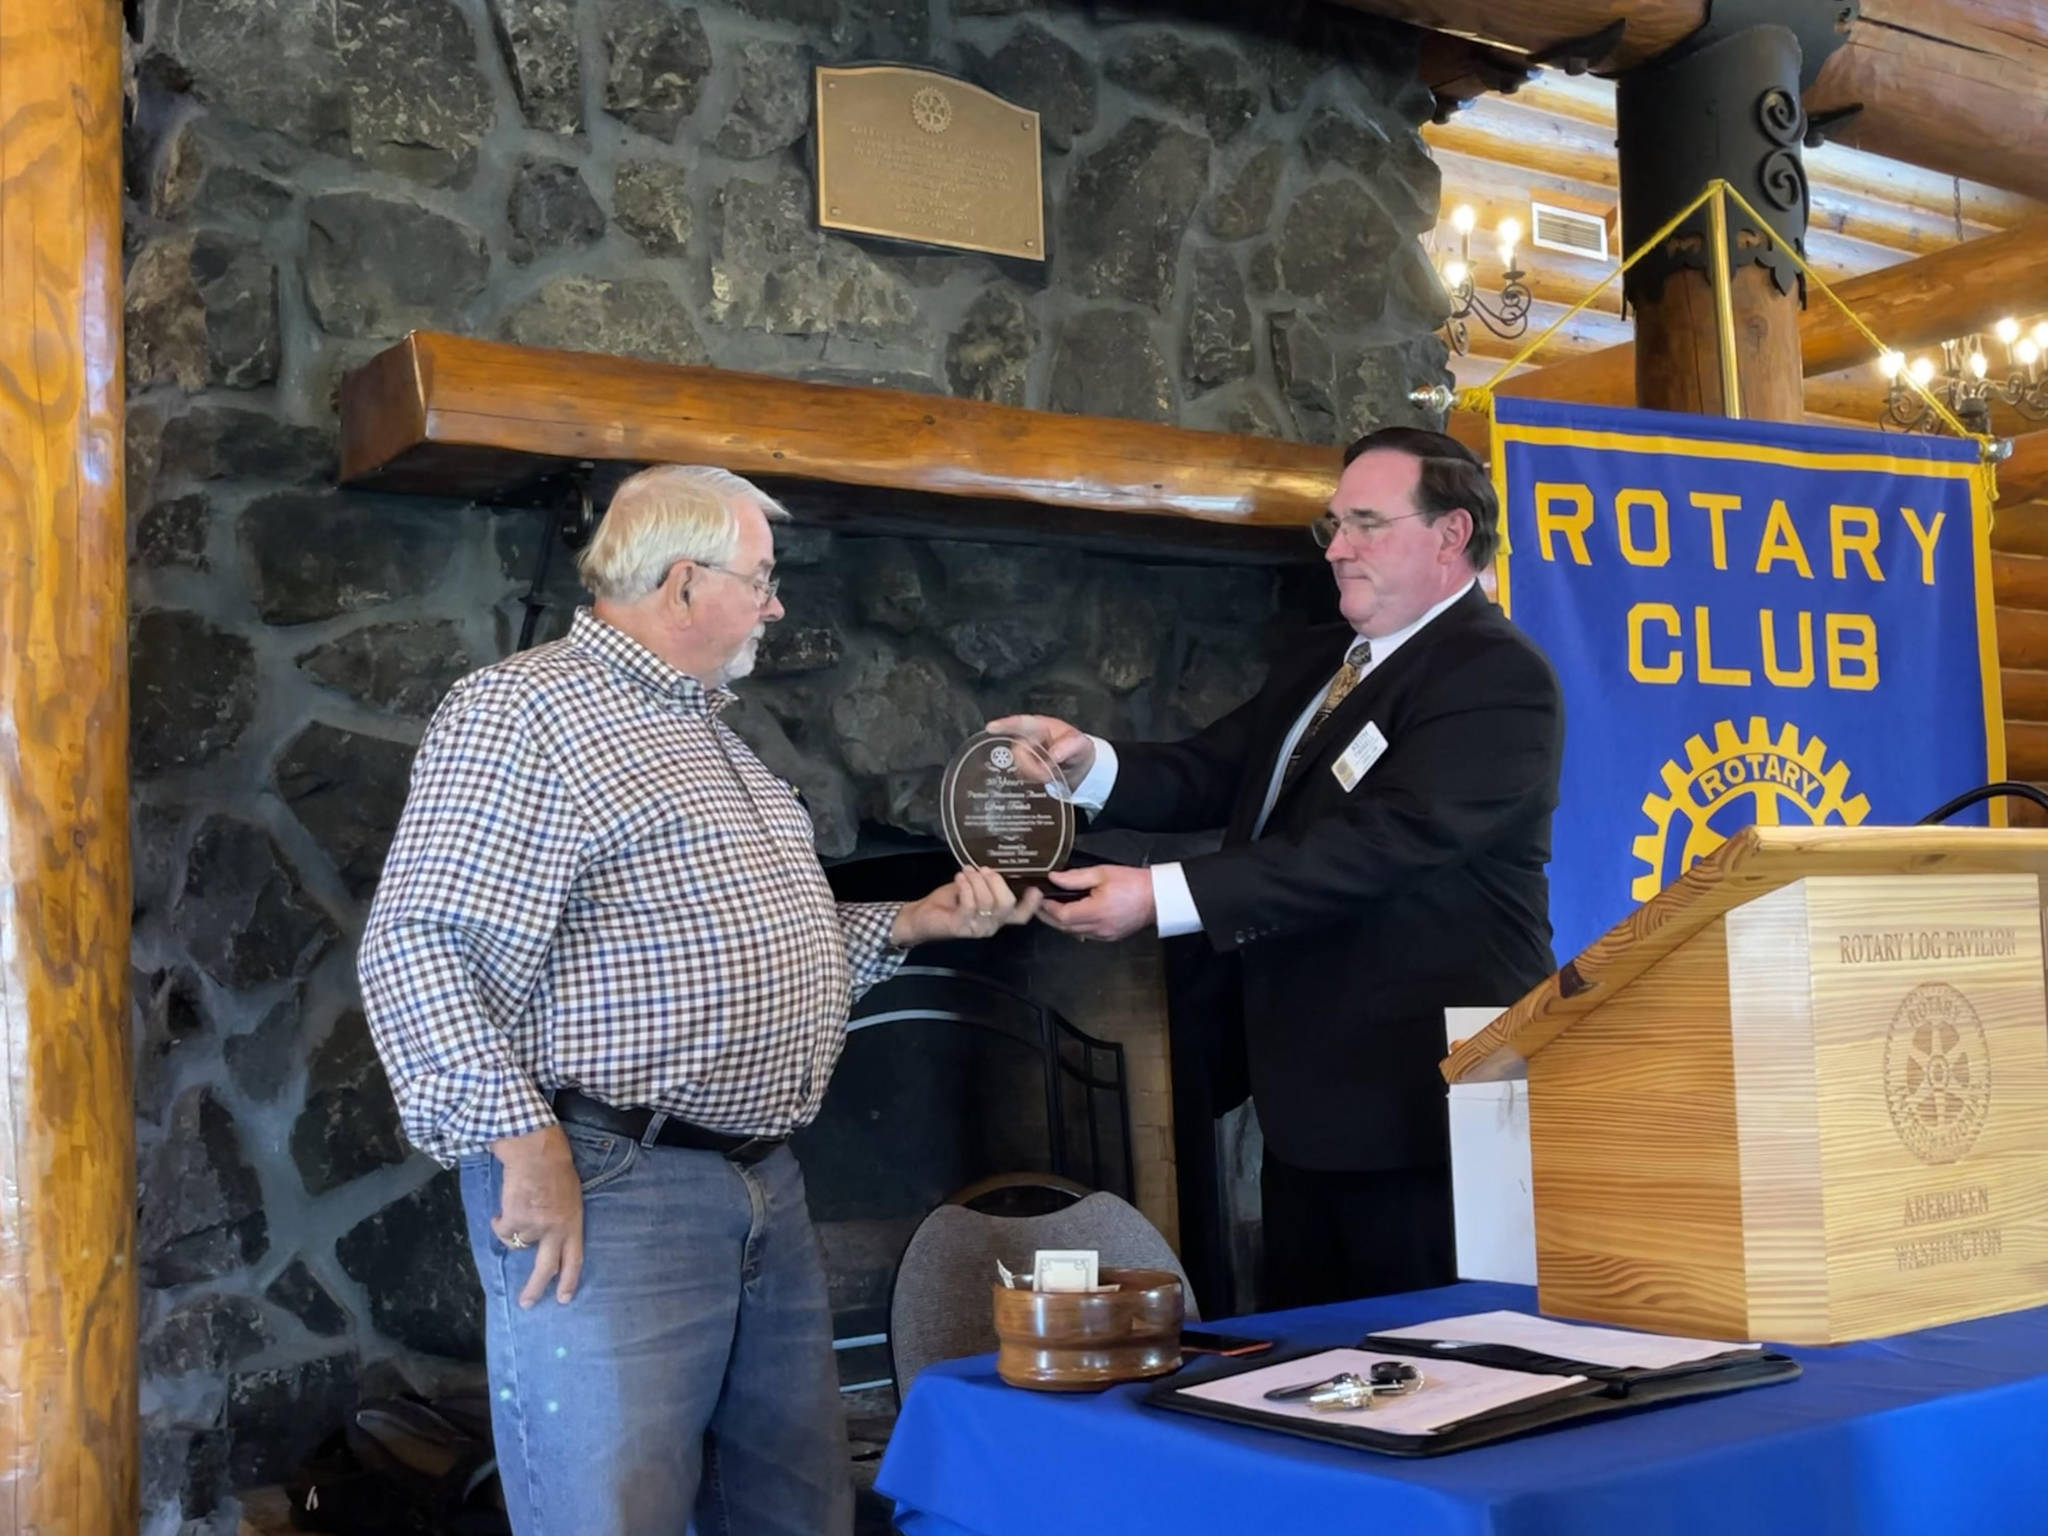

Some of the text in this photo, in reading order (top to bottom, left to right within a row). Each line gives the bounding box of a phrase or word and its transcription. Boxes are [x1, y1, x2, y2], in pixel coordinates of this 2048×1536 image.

[1534, 481, 1946, 586] ROTARY
[1626, 602, 1880, 692] CLUB
[1698, 754, 1820, 801] ROTARY
[1839, 928, 2016, 964] ROTARY LOG PAVILION
[1903, 1184, 1990, 1225] ABERDEEN
[1895, 1228, 2002, 1272] WASHINGTON
